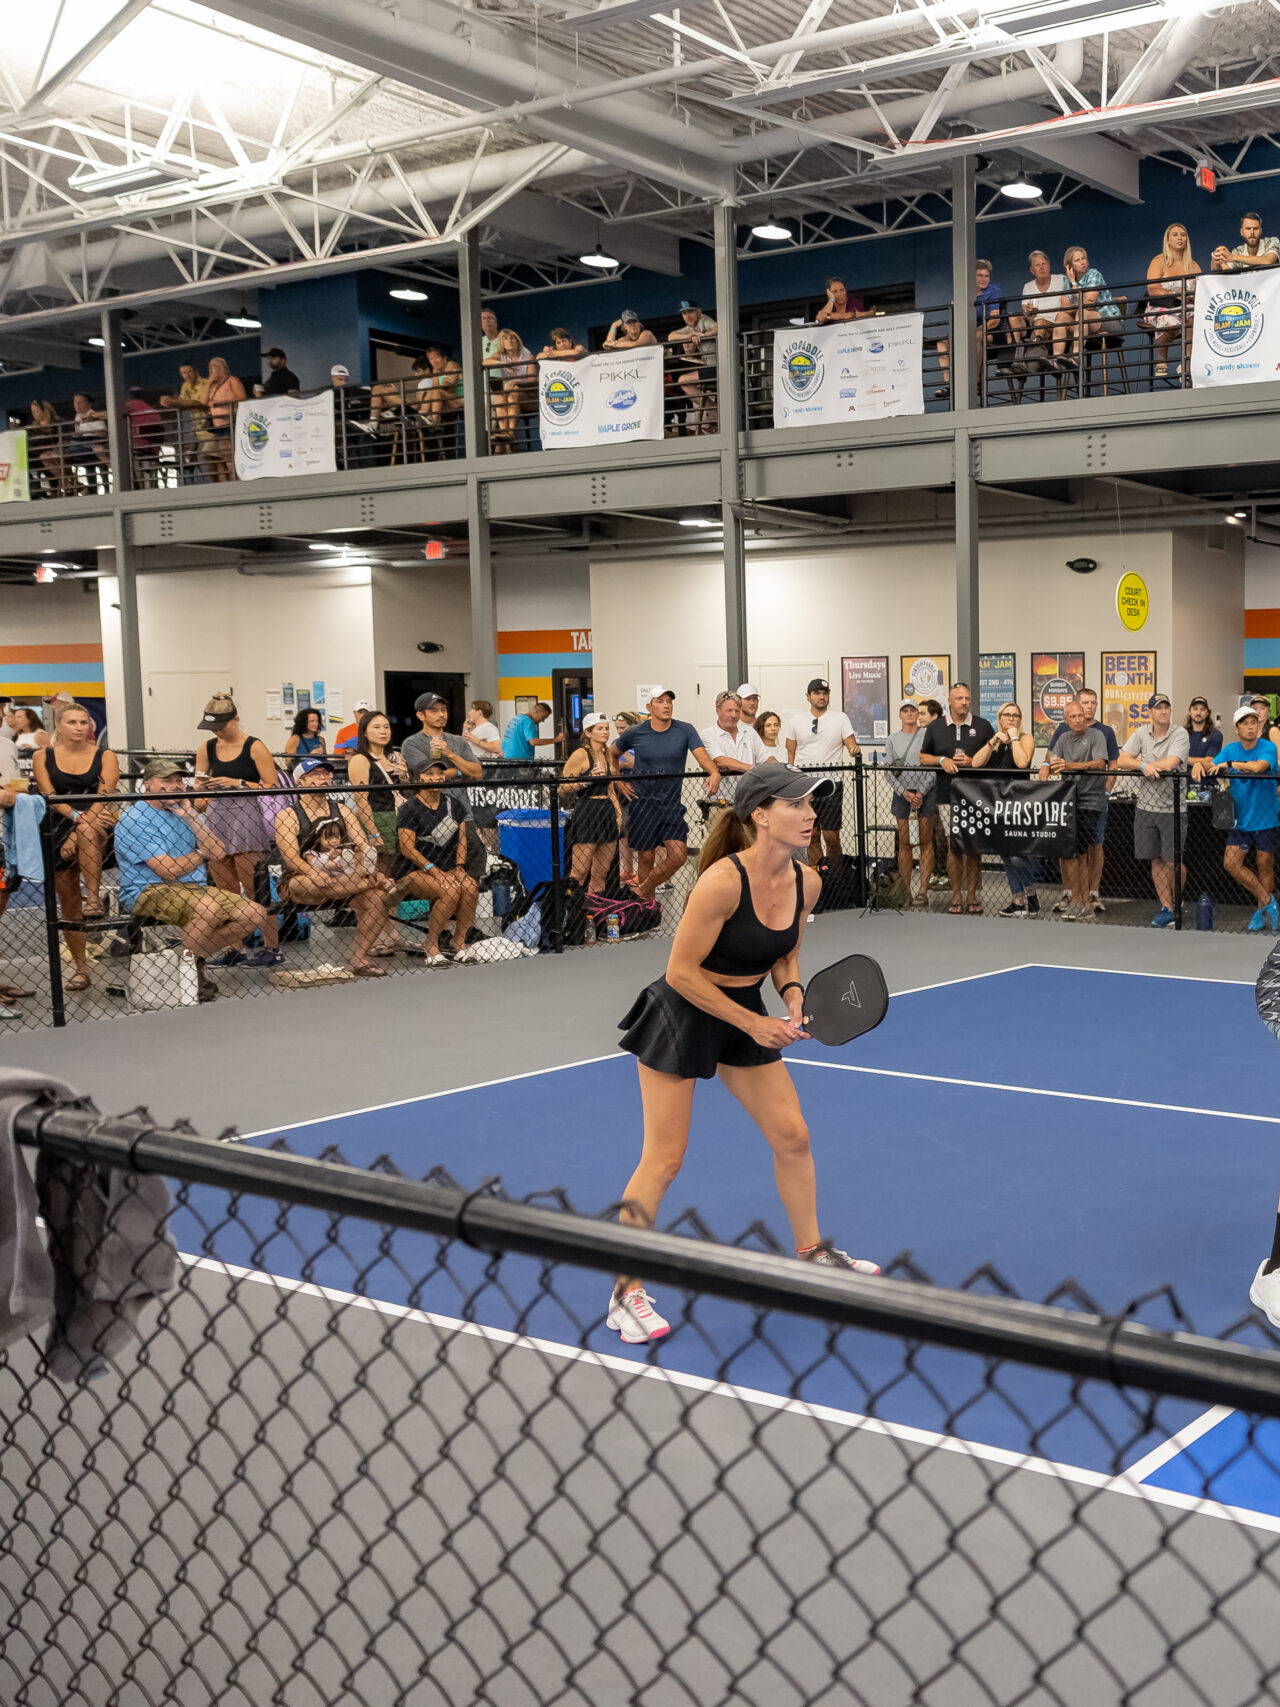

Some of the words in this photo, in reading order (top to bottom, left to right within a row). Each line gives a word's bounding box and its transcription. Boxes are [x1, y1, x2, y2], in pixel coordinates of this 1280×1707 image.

[1231, 289, 1262, 310] PADDLE
[1204, 293, 1223, 321] PINTS
[1214, 321, 1230, 330] SLAM
[1234, 319, 1251, 328] JAM
[600, 369, 647, 382] PIKKL
[598, 424, 620, 434] MAPLE
[621, 420, 641, 431] GROVE
[1125, 587, 1141, 596] COURT
[1121, 597, 1138, 606] CHECK
[1127, 607, 1140, 616] DESK
[844, 660, 886, 670] Thursdays
[994, 660, 1012, 669] JAM
[1105, 655, 1148, 671] BEER
[863, 671, 882, 679] Music
[1129, 703, 1149, 719] $5
[993, 800, 1067, 826] PERSPIRE
[1004, 830, 1028, 838] SAUNA
